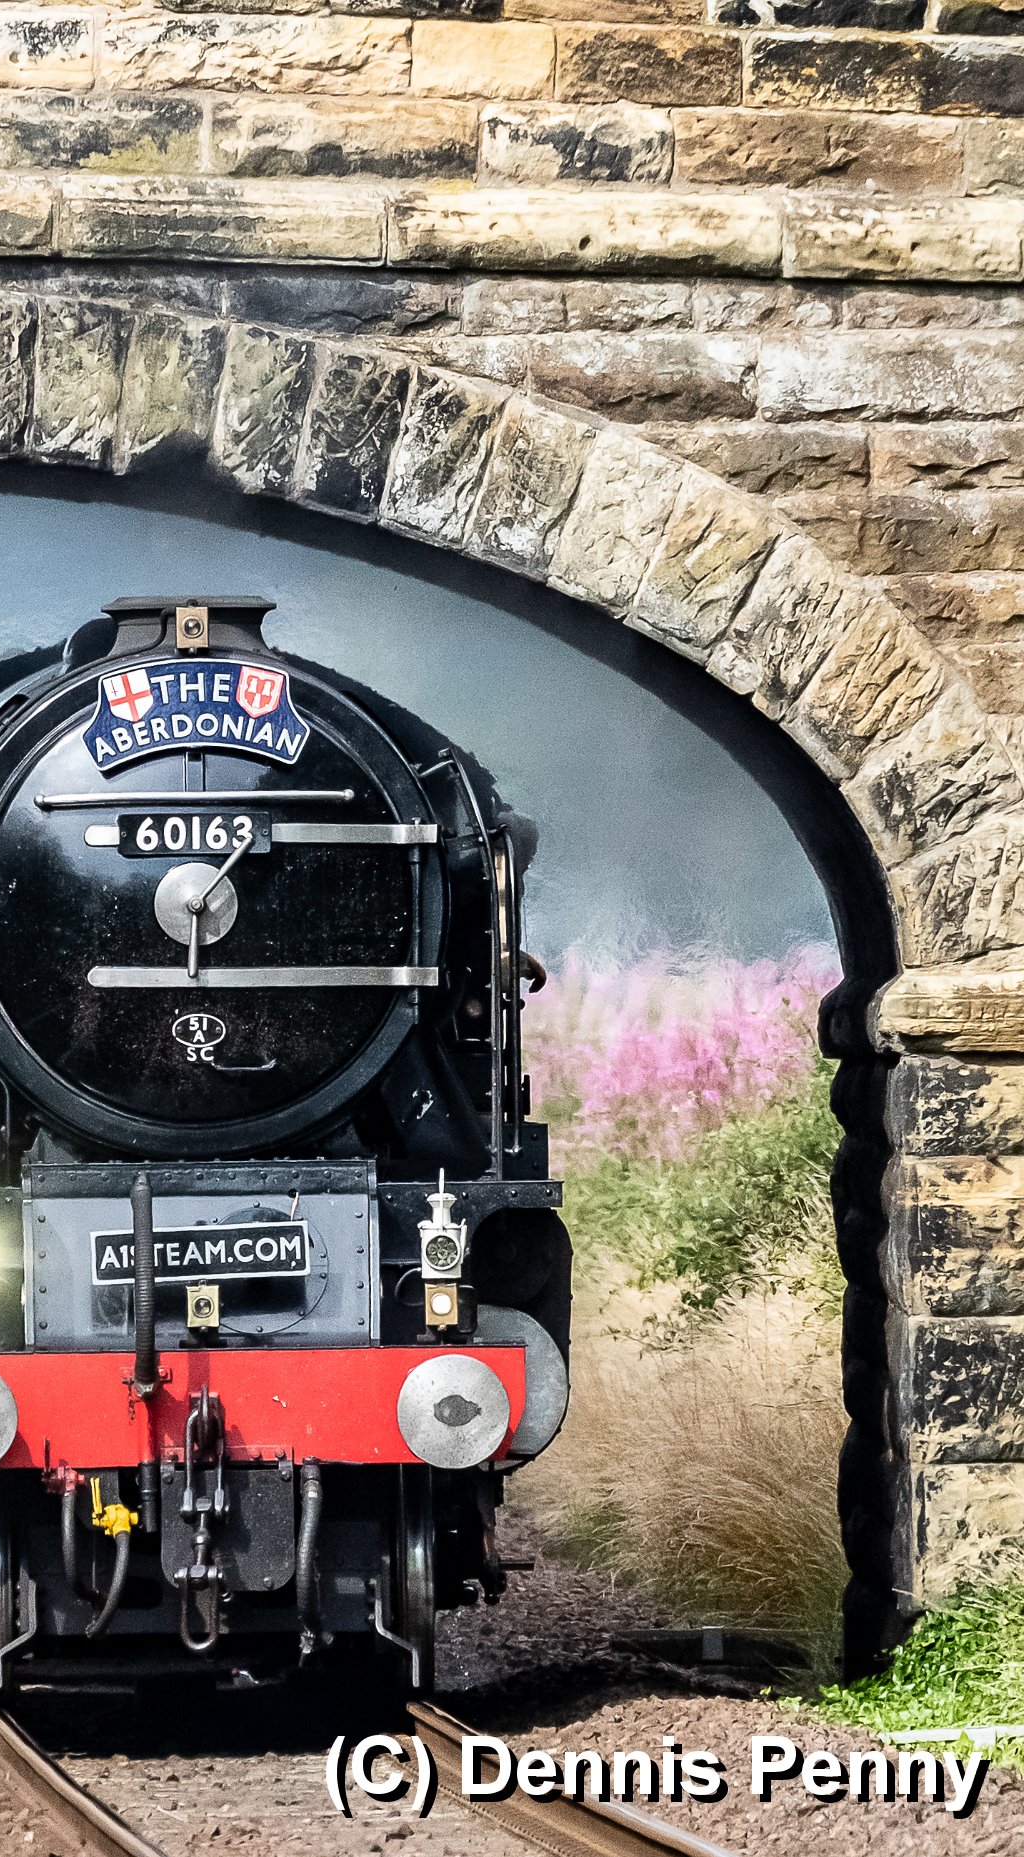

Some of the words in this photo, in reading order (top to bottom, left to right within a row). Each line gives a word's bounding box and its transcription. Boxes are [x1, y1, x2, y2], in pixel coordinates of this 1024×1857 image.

[150, 672, 231, 704] THE
[95, 713, 301, 762] ABERDONIAN
[135, 815, 253, 851] 60163
[189, 1017, 208, 1031] 51
[193, 1029, 206, 1043] A
[99, 1235, 302, 1270] A1TEAM.COM
